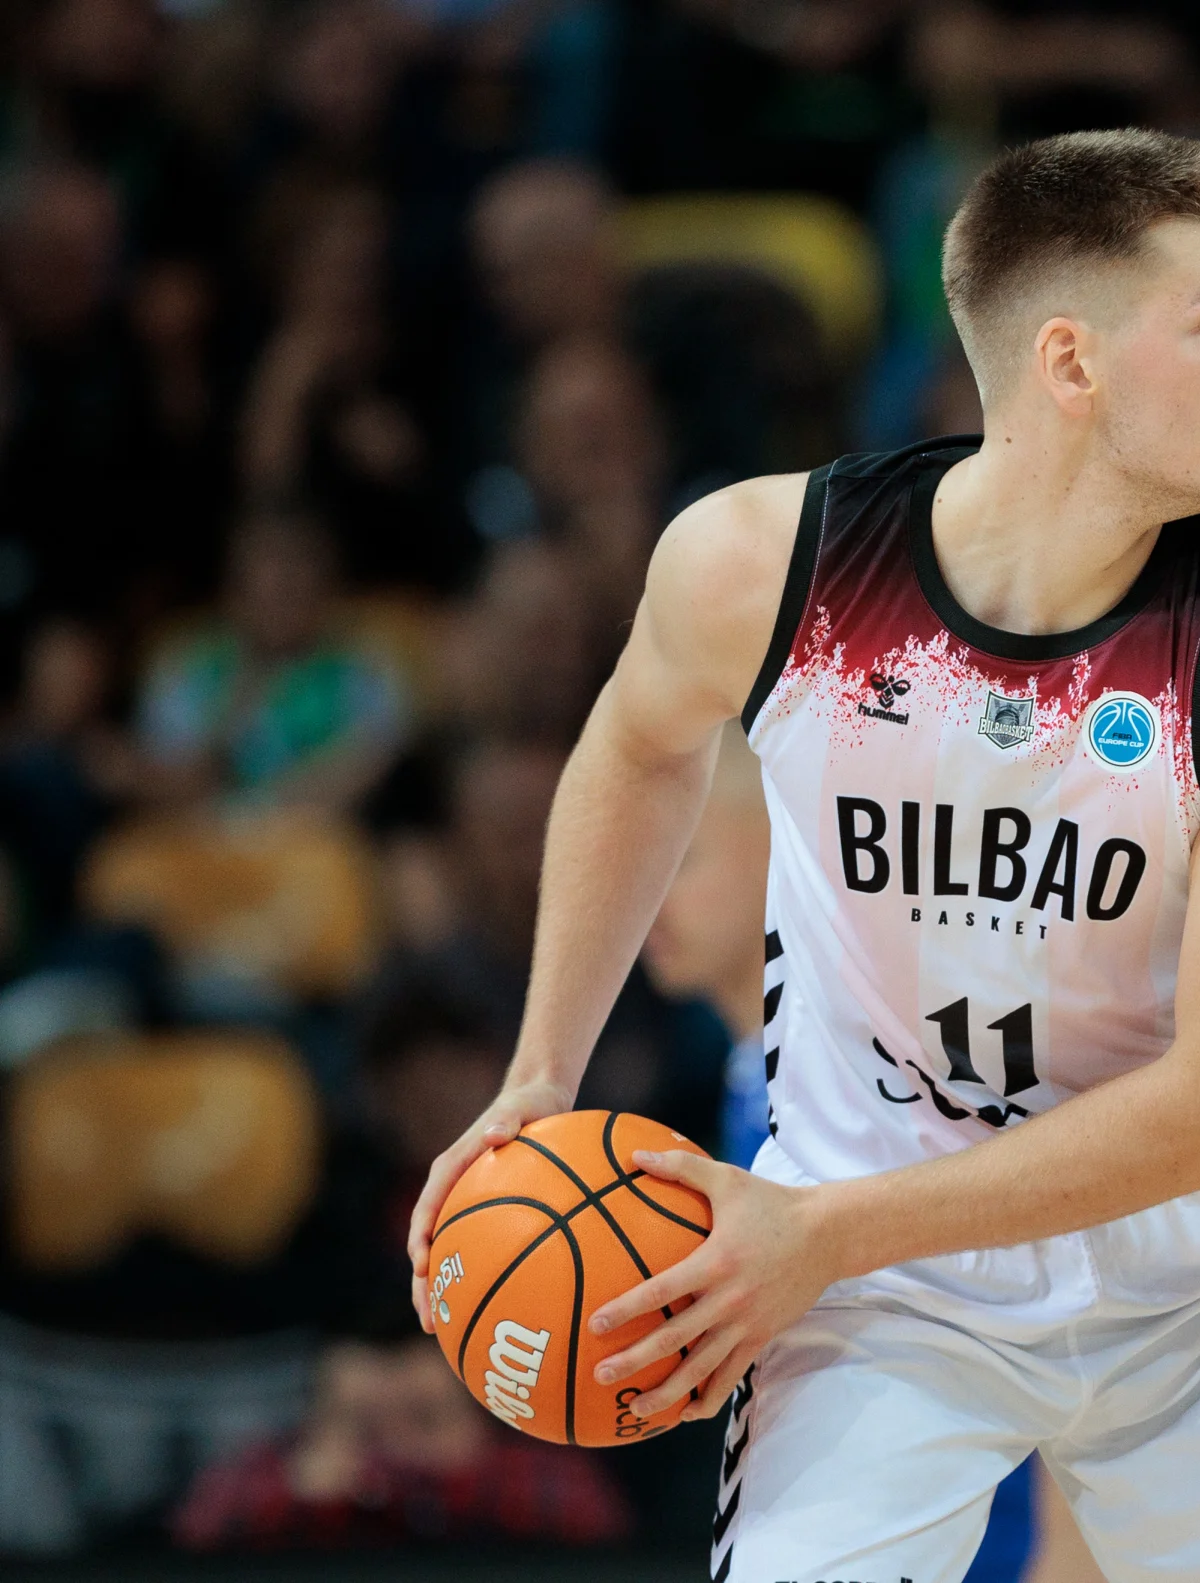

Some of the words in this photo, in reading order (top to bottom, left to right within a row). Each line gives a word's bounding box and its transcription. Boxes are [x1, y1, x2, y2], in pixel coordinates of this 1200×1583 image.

[857, 702, 909, 725] hummel
[1098, 737, 1128, 747] EUROPE
[1112, 732, 1133, 740] FIBA
[836, 795, 1147, 922] BILBAO
[911, 908, 1047, 939] BASKET
[925, 996, 1040, 1097] 11
